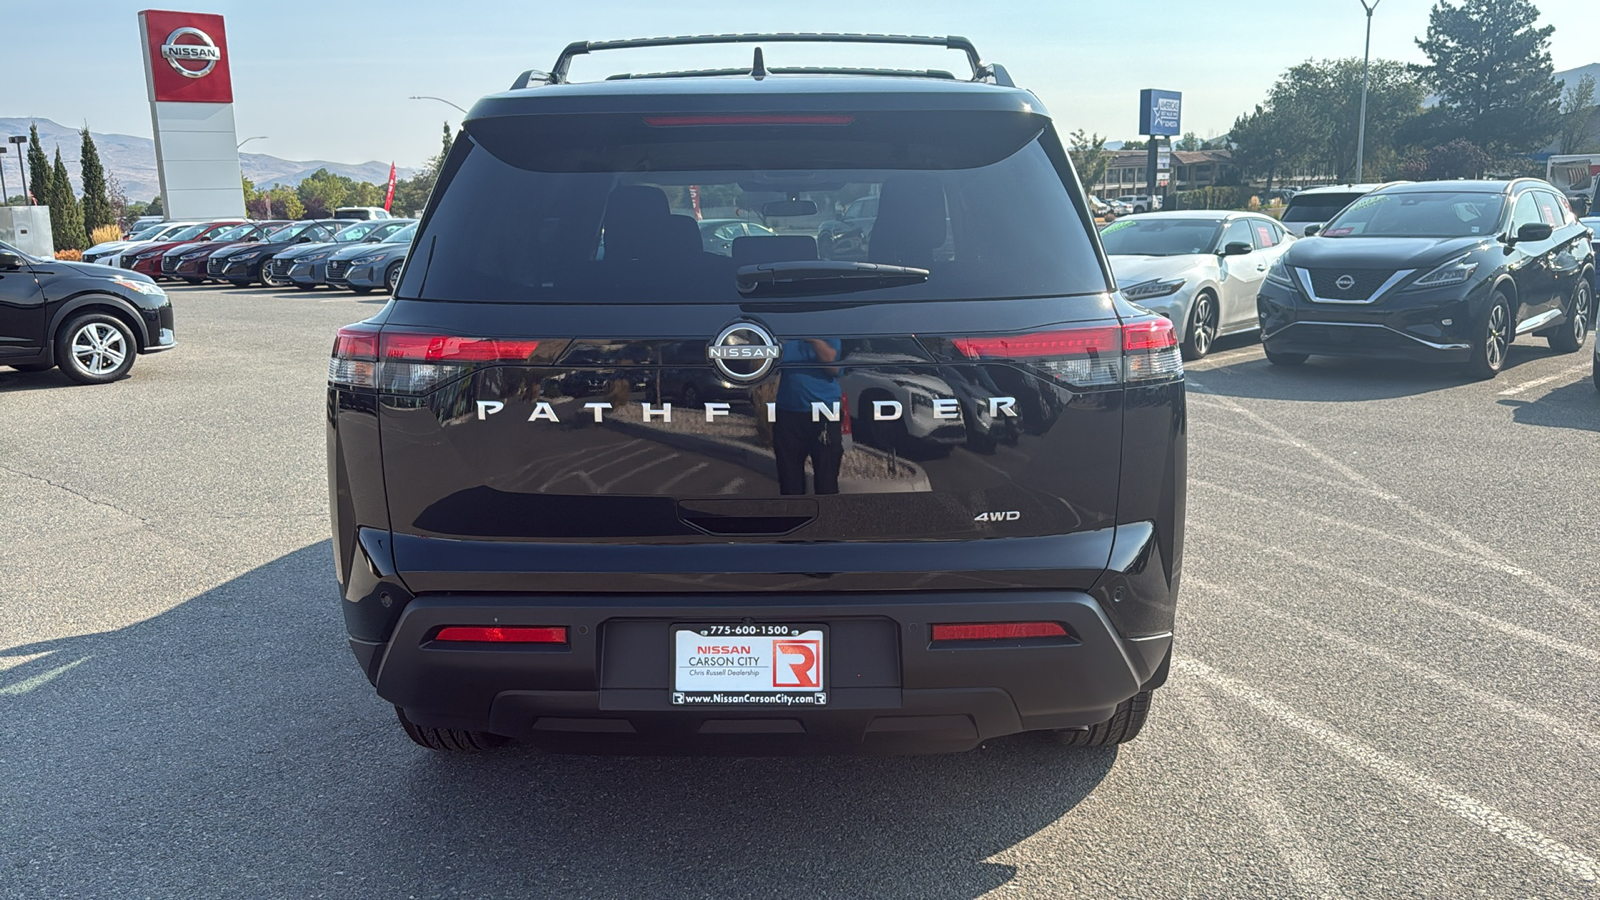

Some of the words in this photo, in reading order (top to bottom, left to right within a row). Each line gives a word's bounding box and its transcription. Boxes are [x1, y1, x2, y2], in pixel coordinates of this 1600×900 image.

[168, 47, 216, 57] NISSAN
[710, 348, 777, 357] NISSAN
[476, 396, 1017, 423] PATHFINDER
[974, 511, 1020, 521] 4WD
[710, 625, 789, 635] 775-600-1500
[697, 646, 751, 654] NISSAN
[688, 656, 734, 666] CARSON
[737, 656, 760, 666] CITY
[727, 669, 760, 677] Dealership
[686, 693, 814, 705] www.NissanCarsonCity.com
